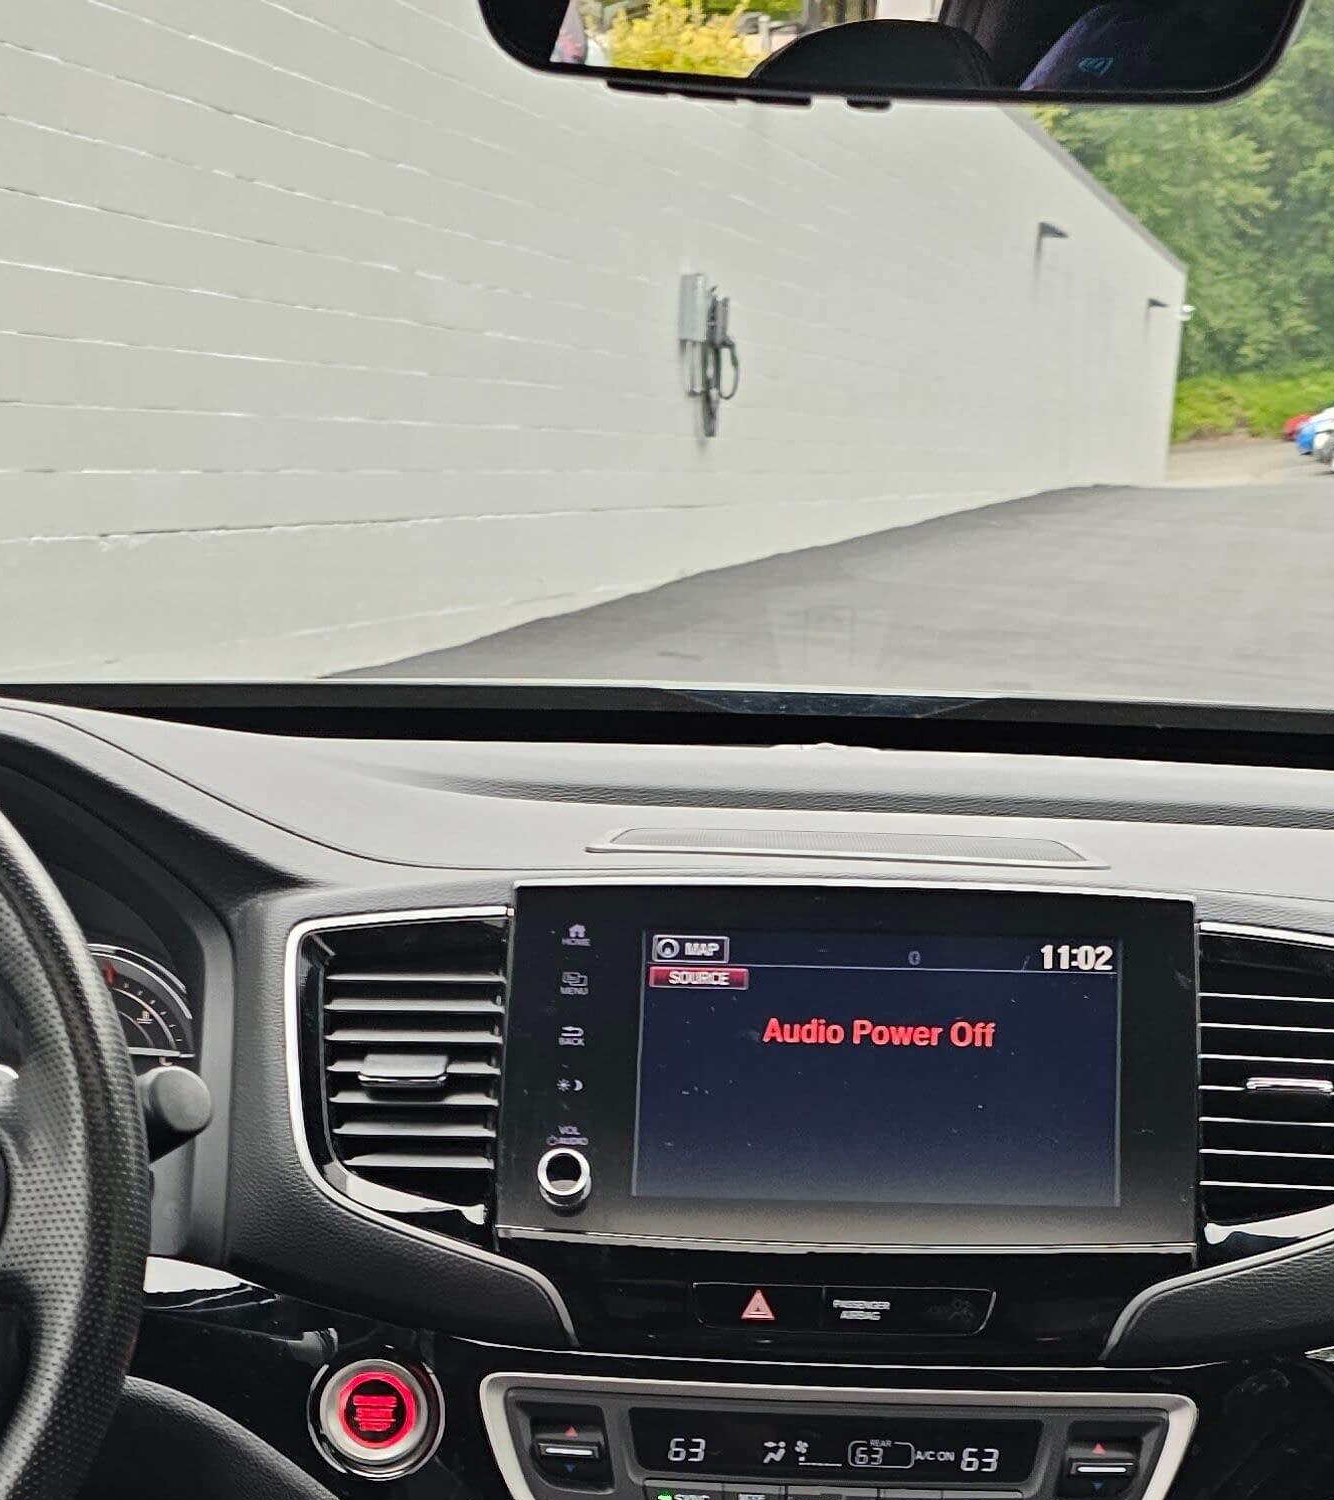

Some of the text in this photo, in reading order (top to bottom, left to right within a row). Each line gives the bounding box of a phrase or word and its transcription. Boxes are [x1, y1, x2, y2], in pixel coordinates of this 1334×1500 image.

[684, 942, 719, 956] MAP
[1040, 944, 1113, 970] 11:02
[668, 970, 730, 985] SOURCE
[762, 1017, 996, 1047] Audio Power Off
[667, 1438, 706, 1461] 63
[870, 1439, 892, 1447] REAR
[854, 1447, 883, 1465] 63
[915, 1450, 955, 1462] A/C ON
[960, 1447, 1000, 1472] 63
